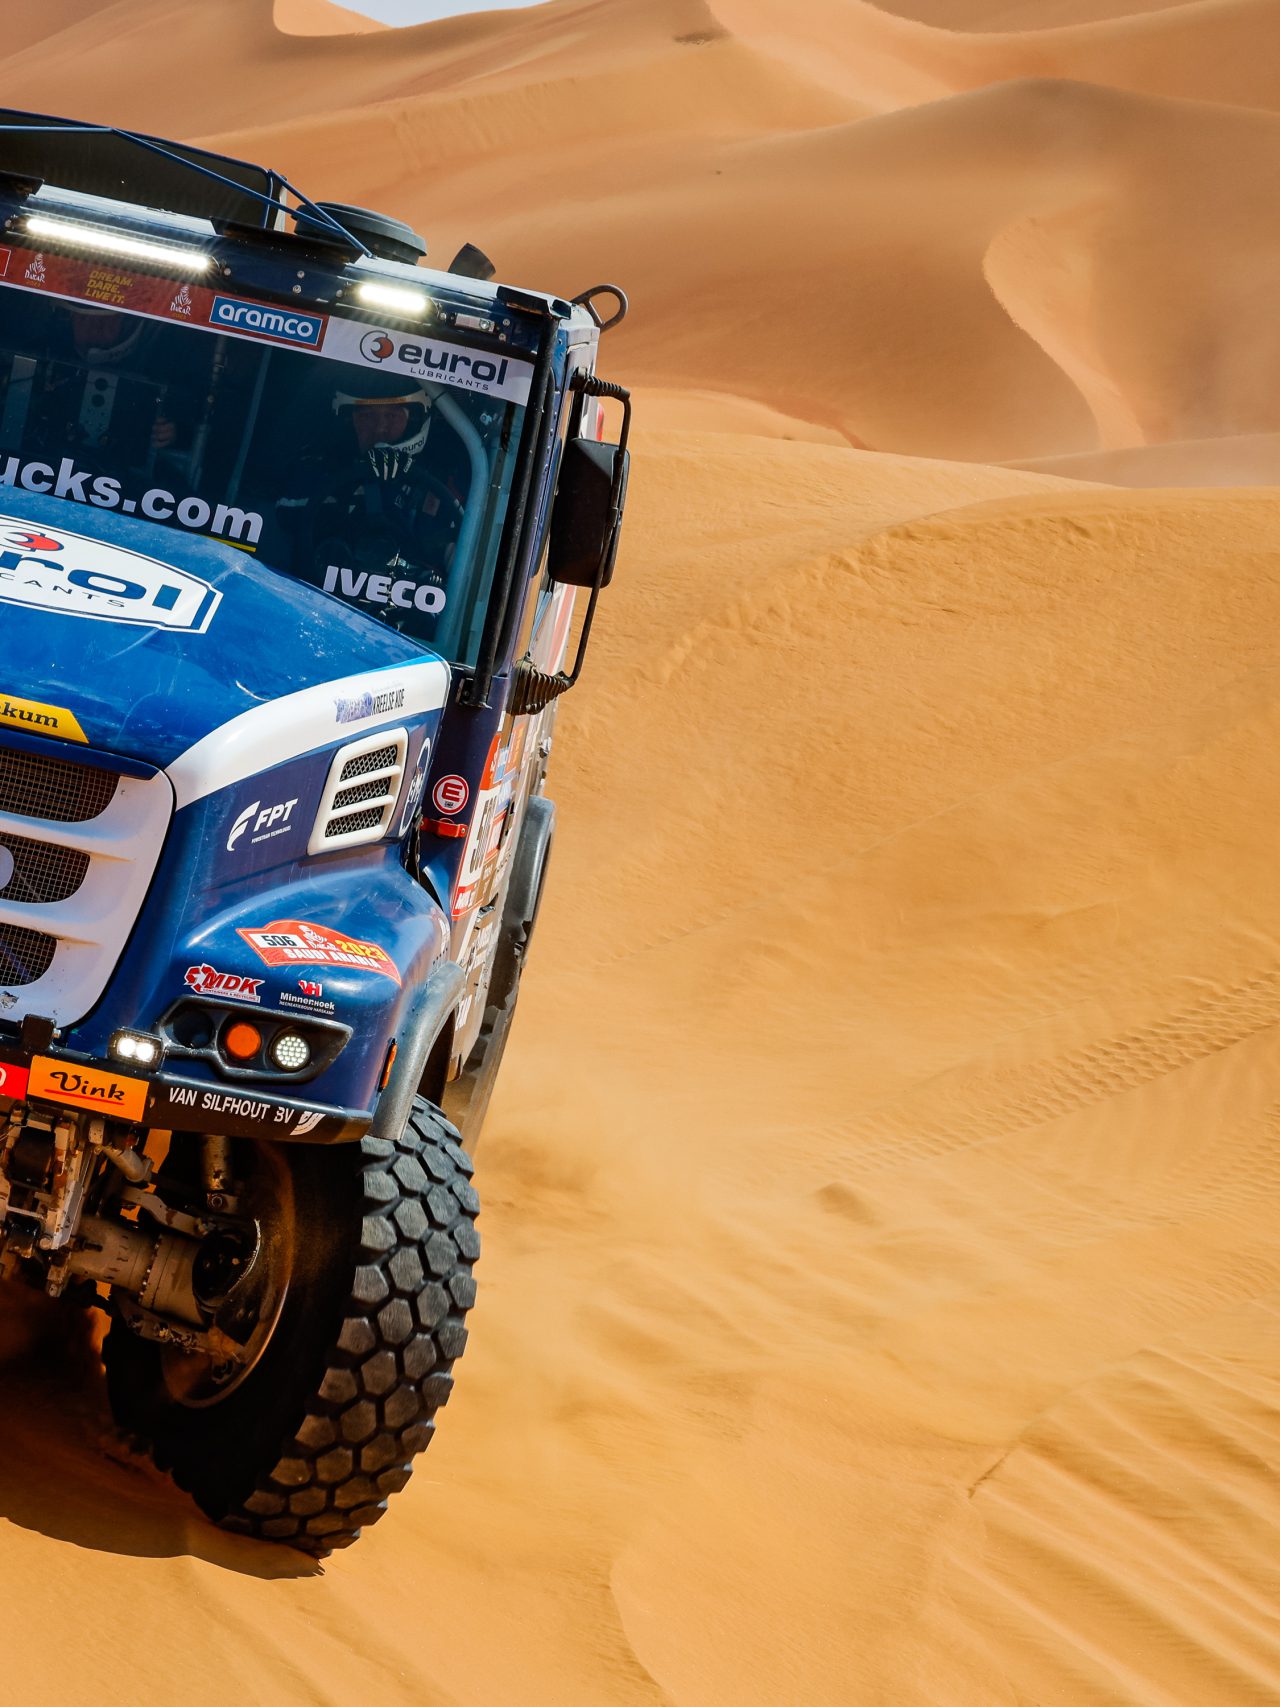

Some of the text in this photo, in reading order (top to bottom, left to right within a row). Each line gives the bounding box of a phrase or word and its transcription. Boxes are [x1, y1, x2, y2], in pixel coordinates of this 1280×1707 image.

[86, 279, 120, 294] DARE.
[89, 270, 134, 287] DREAM.
[85, 288, 125, 304] LIVE IT.
[218, 303, 314, 338] aramco
[398, 343, 509, 386] eurol
[410, 367, 489, 391] LUBRICANTS
[322, 565, 447, 614] IVECO
[253, 797, 299, 833] FPT
[261, 934, 298, 948] 506
[334, 939, 388, 963] 2023
[282, 948, 383, 969] SAUDI ARABIA
[202, 972, 263, 995] MDK
[49, 1071, 126, 1101] Vink
[169, 1086, 296, 1125] VAN SILFHOUT BV
